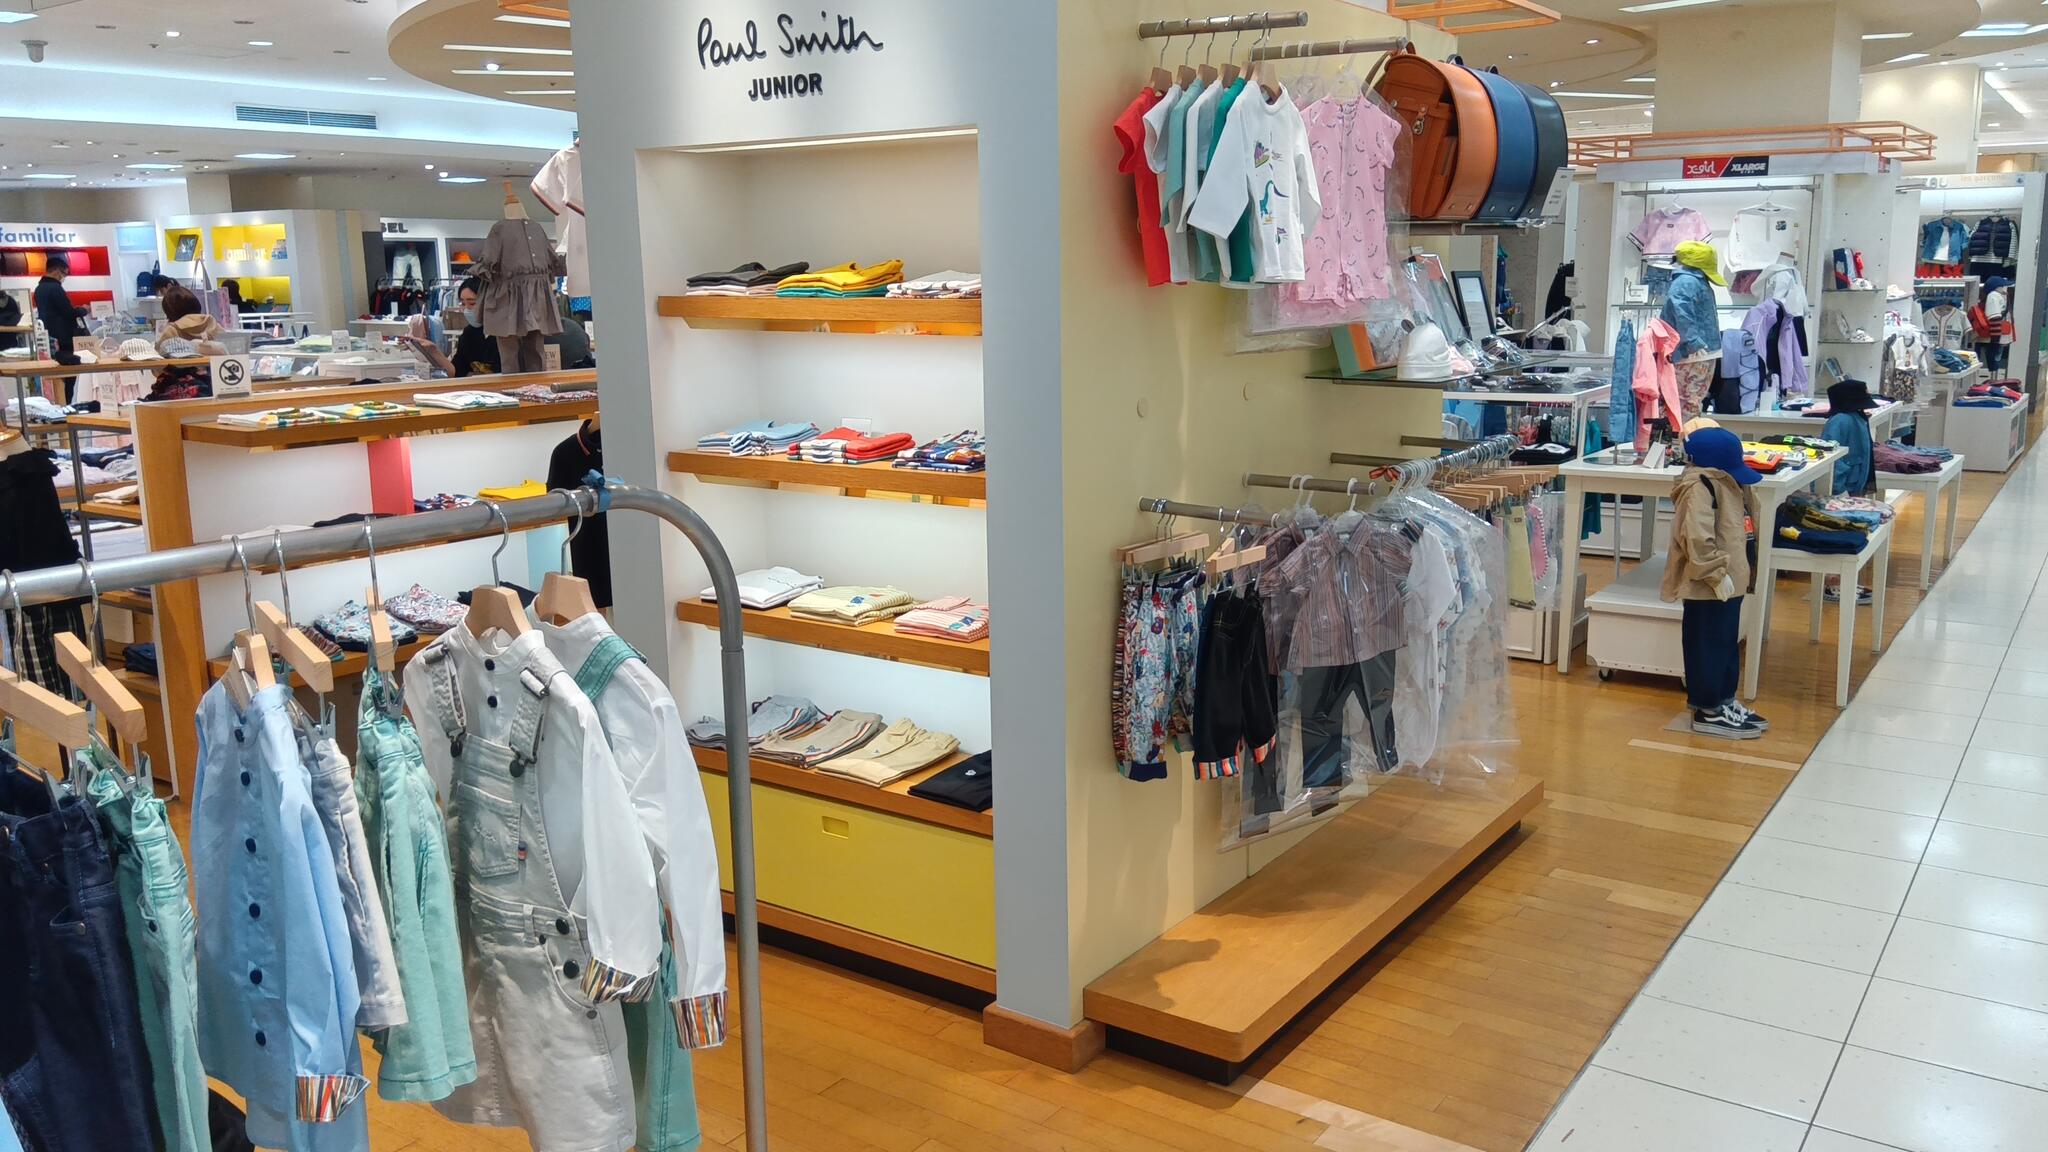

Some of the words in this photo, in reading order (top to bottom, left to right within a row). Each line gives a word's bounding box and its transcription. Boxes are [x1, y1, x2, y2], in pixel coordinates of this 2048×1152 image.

[698, 17, 767, 70] Paul
[777, 10, 884, 58] Smith
[748, 73, 824, 101] JUNIOR
[1731, 163, 1766, 172] XLARGE
[0, 227, 76, 243] familiar
